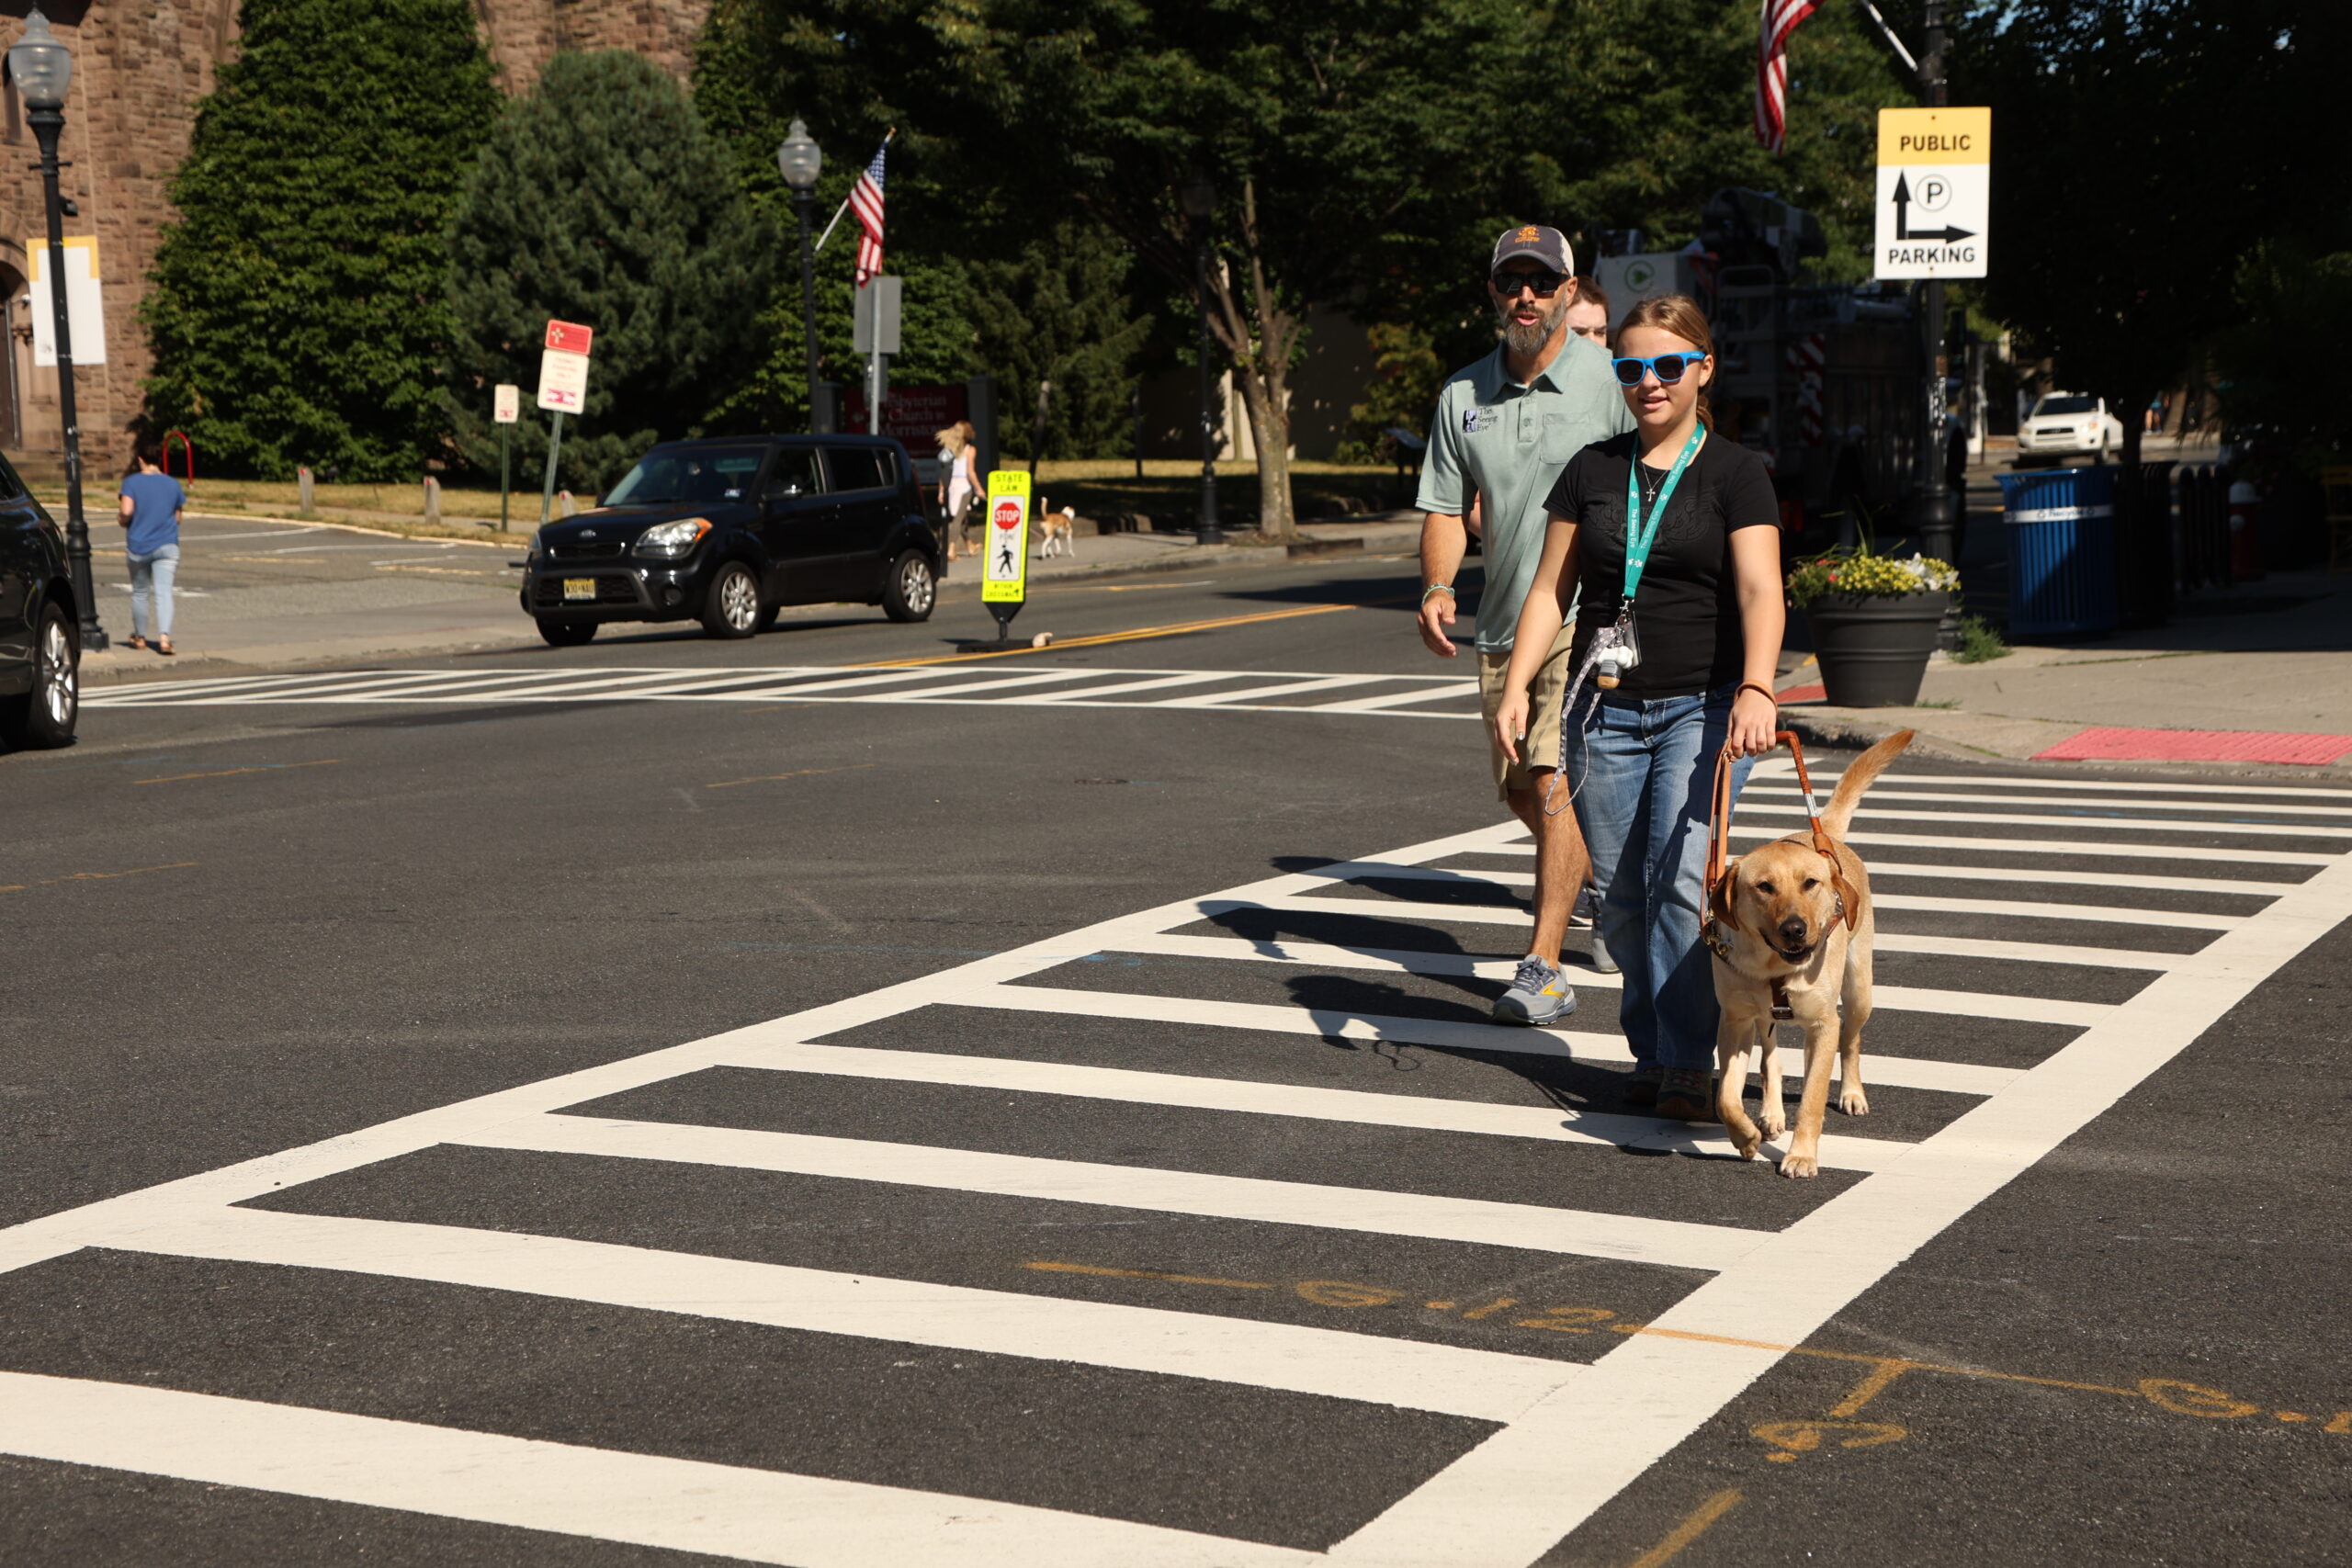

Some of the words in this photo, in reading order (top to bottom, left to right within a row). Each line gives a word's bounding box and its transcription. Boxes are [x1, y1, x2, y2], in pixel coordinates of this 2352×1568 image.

[1900, 134, 1971, 152] PUBLIC
[1927, 183, 1943, 204] P
[1889, 246, 1975, 265] PARKING
[996, 473, 1023, 483] STATE
[1667, 475, 1676, 484] The
[1673, 459, 1686, 475] Seeing
[995, 510, 1020, 523] STOP
